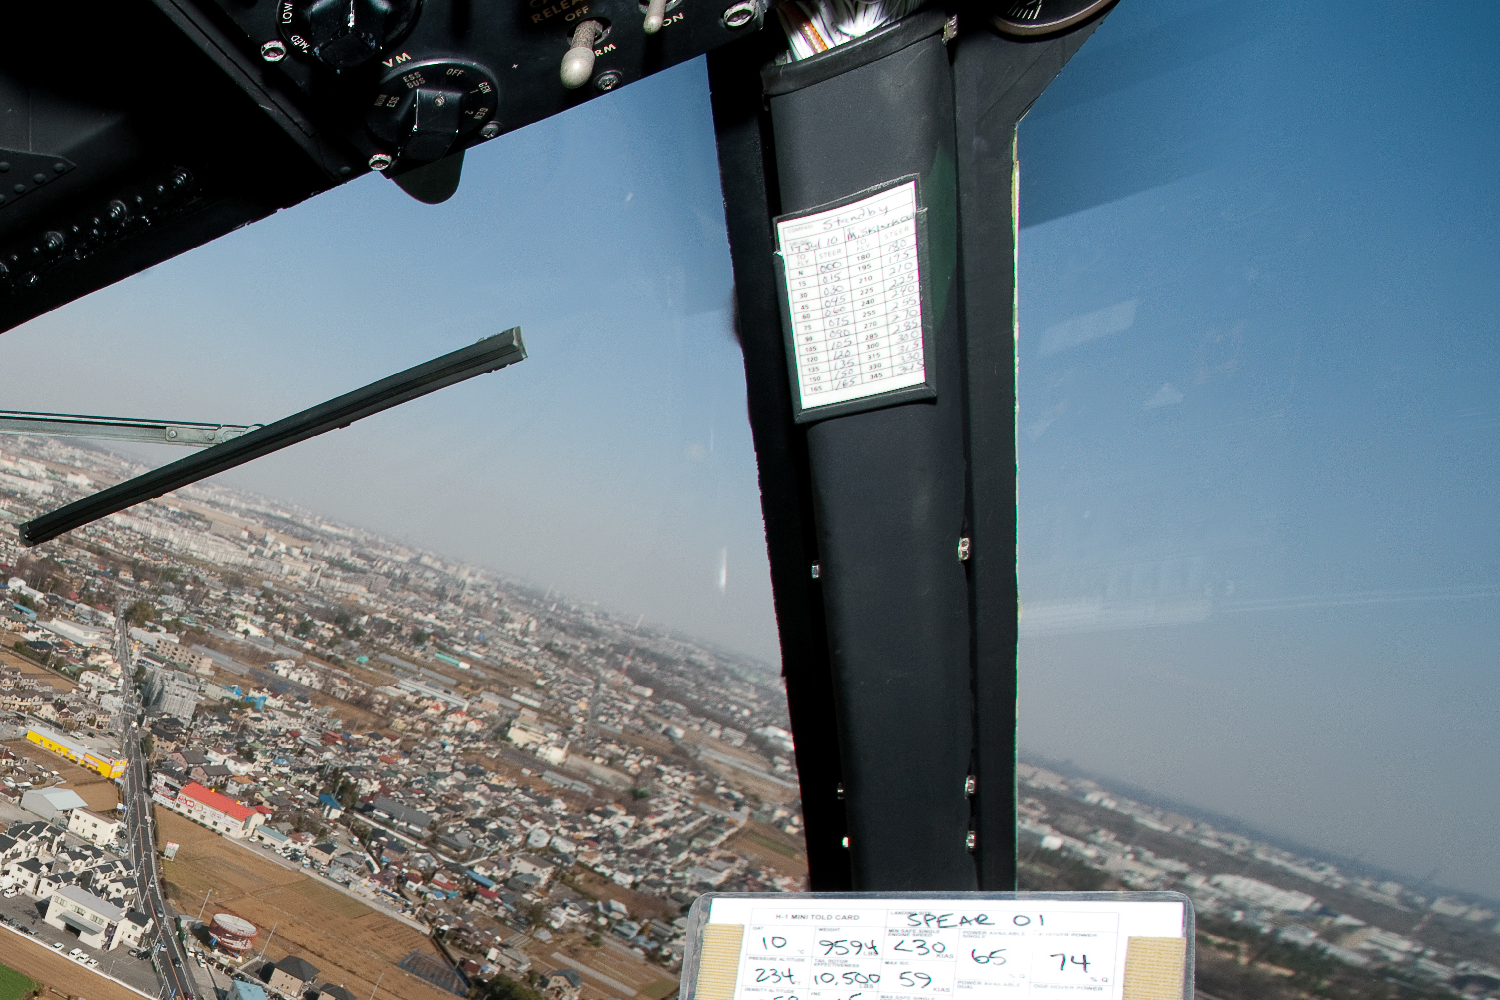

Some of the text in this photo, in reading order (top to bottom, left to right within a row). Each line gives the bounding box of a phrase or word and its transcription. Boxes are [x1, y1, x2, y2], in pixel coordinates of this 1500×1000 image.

[564, 6, 589, 22] OFF
[382, 52, 412, 68] VM
[858, 275, 873, 284] 210
[859, 287, 874, 295] 225
[862, 309, 876, 318] 255
[863, 321, 878, 329] 270
[907, 913, 996, 929] SPEAR
[762, 936, 788, 950] 10
[971, 948, 1007, 966] 65
[1050, 953, 1091, 973] 74
[755, 968, 796, 985] 234
[899, 971, 933, 989] 59
